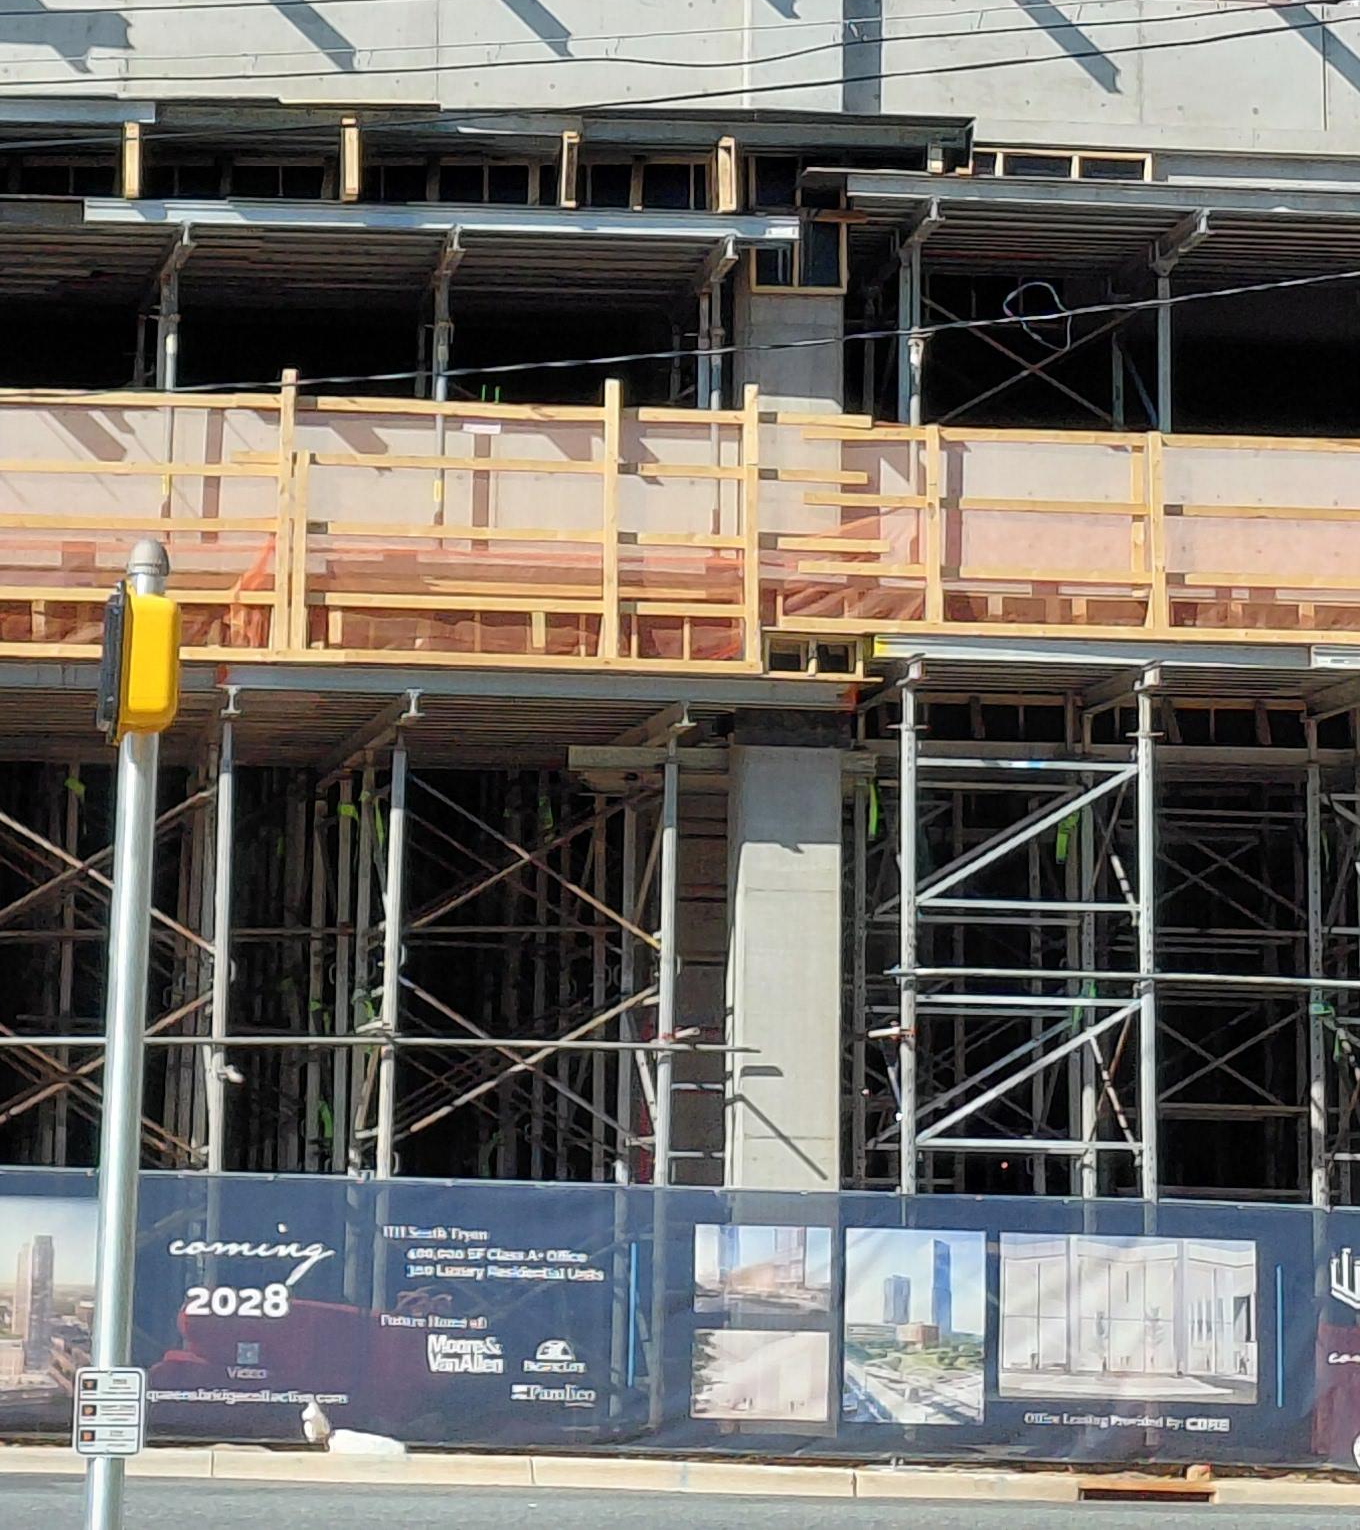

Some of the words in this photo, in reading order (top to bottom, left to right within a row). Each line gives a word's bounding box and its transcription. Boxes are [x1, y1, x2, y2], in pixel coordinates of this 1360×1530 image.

[168, 1222, 337, 1286] coming
[546, 1250, 589, 1263] Office
[185, 1283, 290, 1317] 2028
